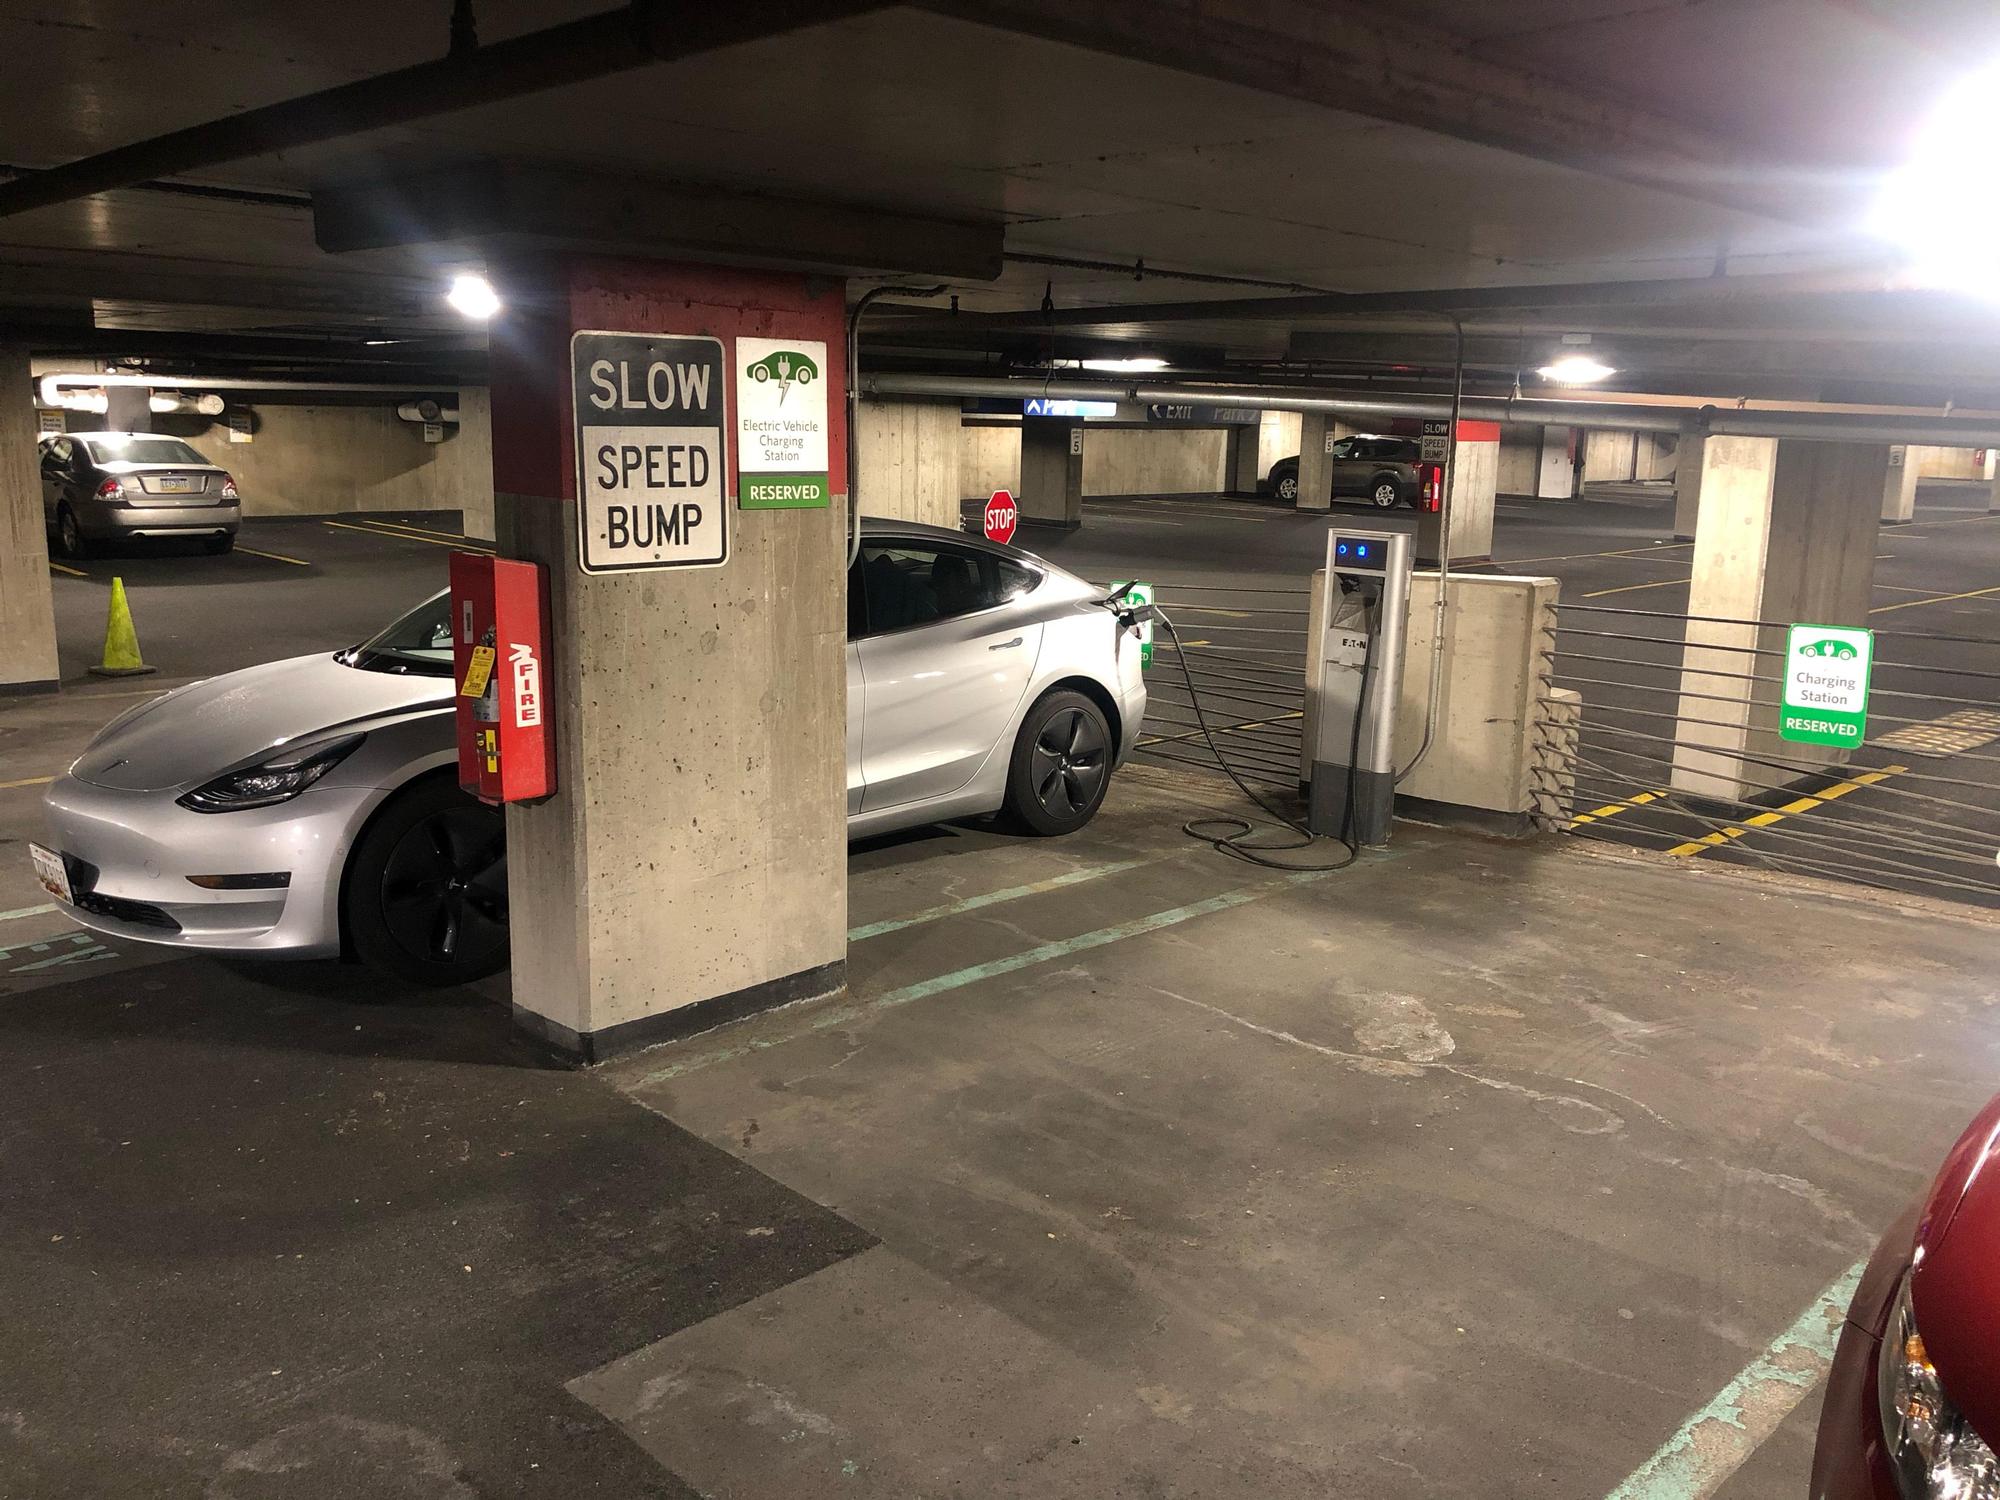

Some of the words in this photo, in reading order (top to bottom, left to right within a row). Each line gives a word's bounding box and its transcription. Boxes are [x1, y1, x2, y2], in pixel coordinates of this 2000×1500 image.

[589, 359, 711, 410] SLOW
[743, 419, 781, 432] Electric
[783, 419, 819, 432] Vehicle
[1424, 423, 1448, 434] SLOW
[759, 434, 804, 449] Charging
[1073, 441, 1080, 453] 5
[1327, 442, 1332, 451] 5
[1424, 439, 1446, 448] SPEED
[764, 449, 800, 461] Station
[1424, 449, 1444, 459] BUMP
[597, 445, 710, 490] SPEED
[750, 485, 820, 500] RESERVED
[607, 503, 703, 549] BUMP
[986, 508, 1014, 531] STOP
[1796, 672, 1857, 691] Charging
[519, 663, 535, 720] FIRE
[1800, 689, 1848, 705] Station
[1786, 717, 1858, 737] RESERVED
